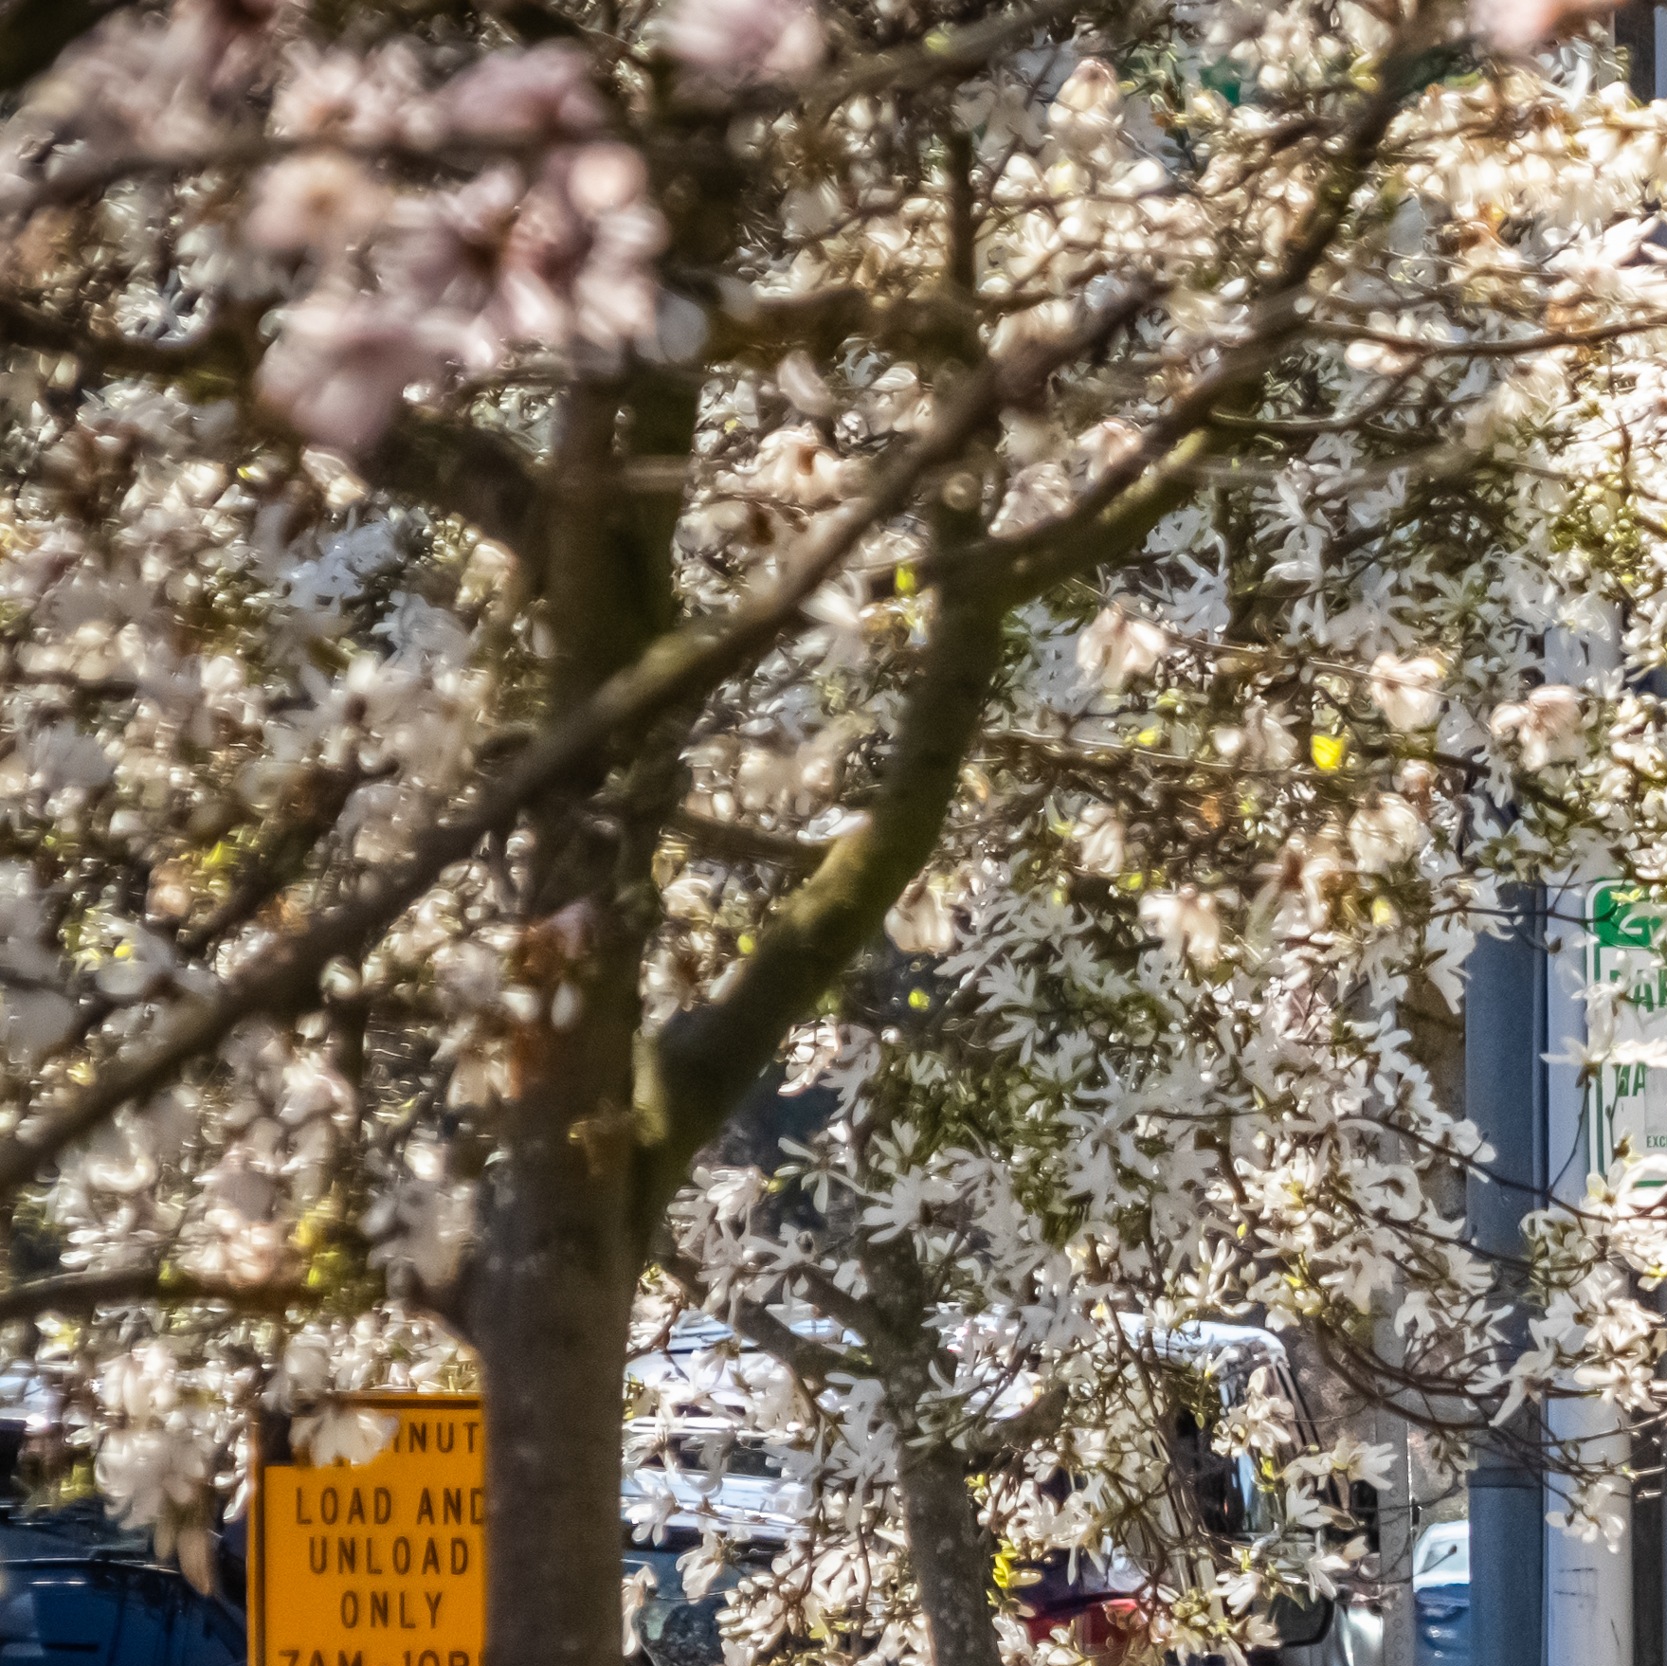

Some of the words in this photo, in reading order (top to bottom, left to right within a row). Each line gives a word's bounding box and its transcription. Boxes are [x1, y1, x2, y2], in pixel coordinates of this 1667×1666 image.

[296, 1487, 392, 1525] LOAD
[416, 1487, 485, 1525] AND
[308, 1535, 469, 1576] UNLOAD
[340, 1590, 443, 1629] ONLY
